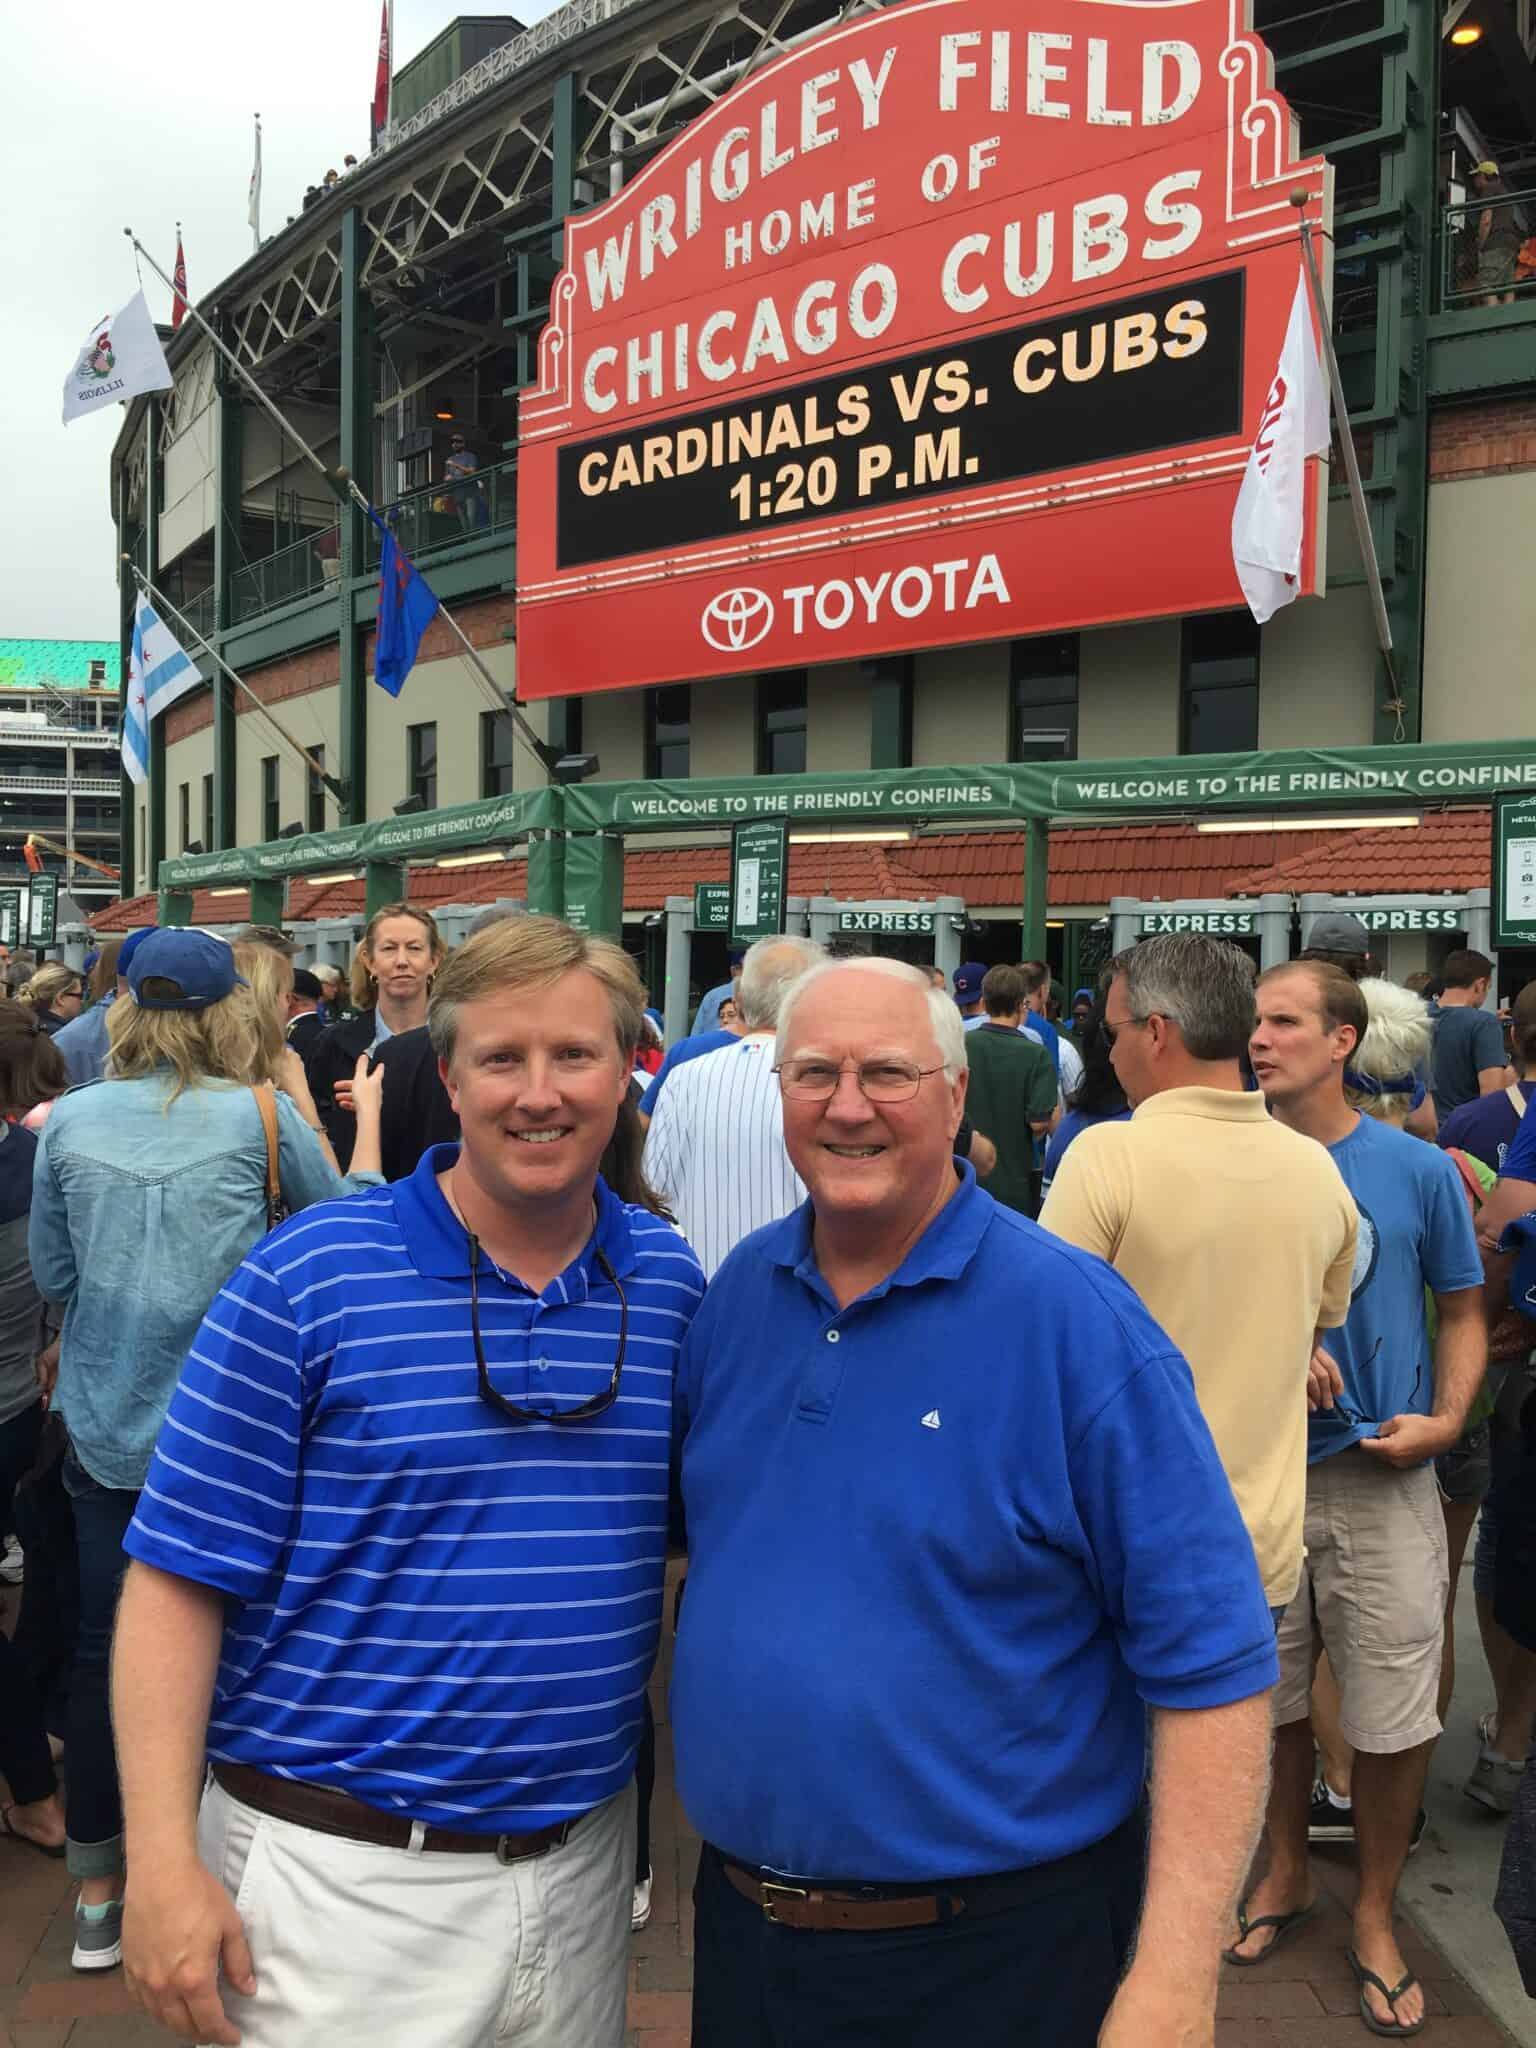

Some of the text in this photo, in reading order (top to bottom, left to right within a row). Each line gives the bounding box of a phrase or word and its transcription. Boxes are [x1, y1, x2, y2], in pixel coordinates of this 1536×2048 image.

[584, 31, 1201, 312] WRIGLEY FIELD
[724, 136, 1000, 270] HOME OF
[583, 170, 1203, 414] CHICAGO CUBS
[578, 299, 1208, 496] CARDINALS VS. CUBS
[730, 427, 979, 521] 1:20 P.M.
[783, 554, 1012, 634] TOYOTA
[631, 786, 993, 815] WELCOME TO THE FRIENDLY CONFINES
[1076, 779, 1189, 799] WELCOME
[1197, 778, 1227, 796] TO
[1235, 774, 1281, 793] THE
[1288, 769, 1410, 792] FRIENDLY
[841, 913, 932, 931] EXPRESS
[1143, 914, 1251, 933] EXPRESS
[1344, 910, 1457, 930] XPRESS
